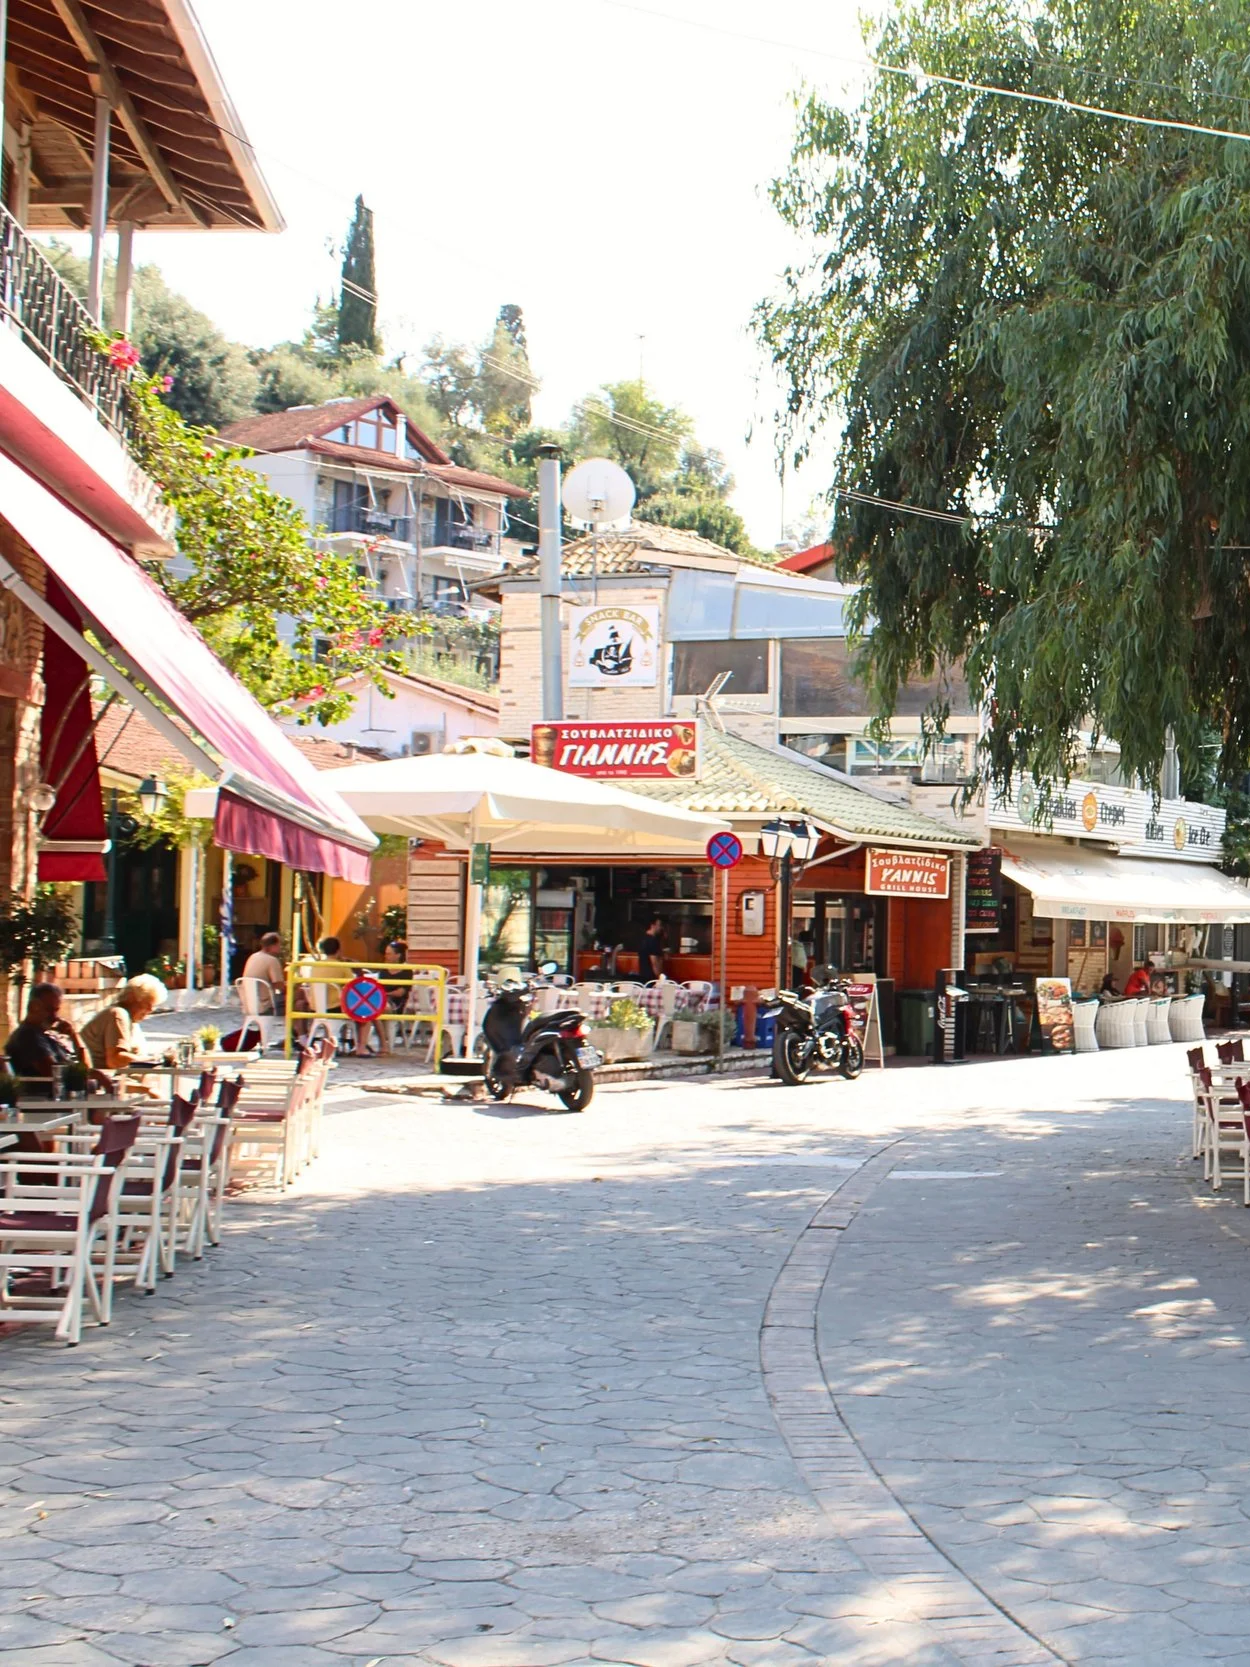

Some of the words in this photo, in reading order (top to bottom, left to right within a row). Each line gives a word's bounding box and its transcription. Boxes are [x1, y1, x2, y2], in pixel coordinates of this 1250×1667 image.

[584, 608, 619, 626] SNACK
[623, 610, 644, 625] BAR
[559, 741, 670, 767] ΓΙΑΝΝΗΣ
[881, 868, 938, 886] YANNIS
[880, 884, 906, 892] GRILL
[909, 885, 937, 893] HOUSE
